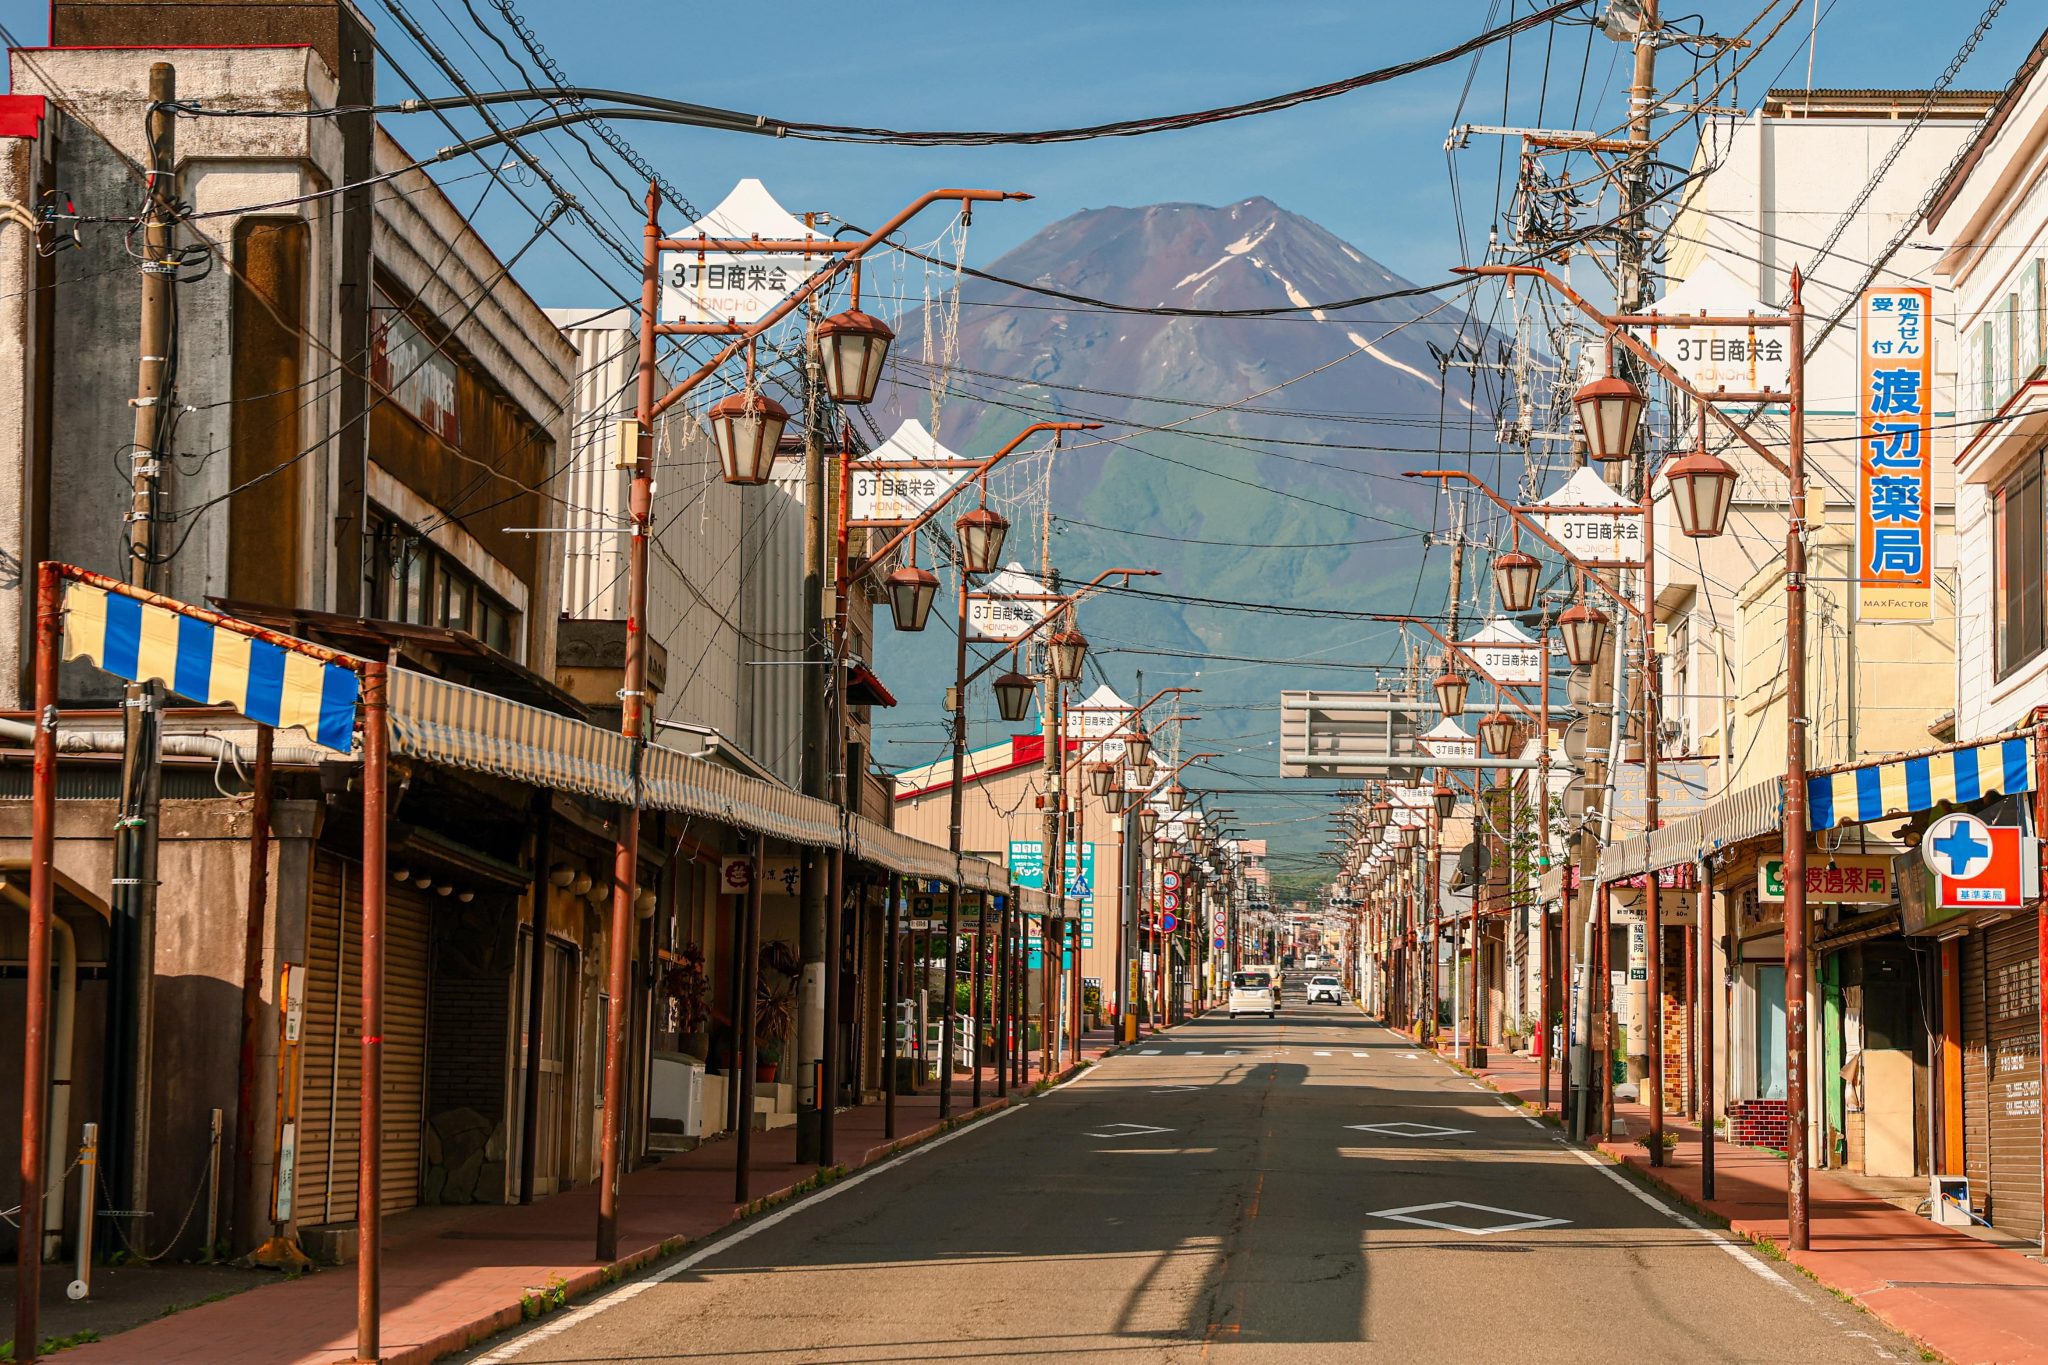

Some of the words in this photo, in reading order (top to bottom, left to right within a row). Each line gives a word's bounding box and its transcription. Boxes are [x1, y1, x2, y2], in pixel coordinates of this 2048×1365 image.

[671, 263, 787, 292] 3丁目商栄会
[689, 296, 758, 312] HONCHO
[1872, 297, 1893, 354] 受付
[1897, 297, 1920, 355] 処方せん
[1677, 338, 1783, 362] 3丁目商栄会
[1694, 367, 1756, 381] HONCHO
[1869, 368, 1922, 575] 渡辺薬局
[857, 478, 936, 497] 3丁目商栄会
[1563, 522, 1639, 540] 3丁目商栄会
[973, 605, 1034, 622] 3丁目商栄会
[982, 623, 1019, 632] HONCHO
[1485, 653, 1539, 667] 3丁目商栄会
[1071, 715, 1115, 727] 3丁目商栄会
[1960, 890, 2003, 900] 基準薬局
